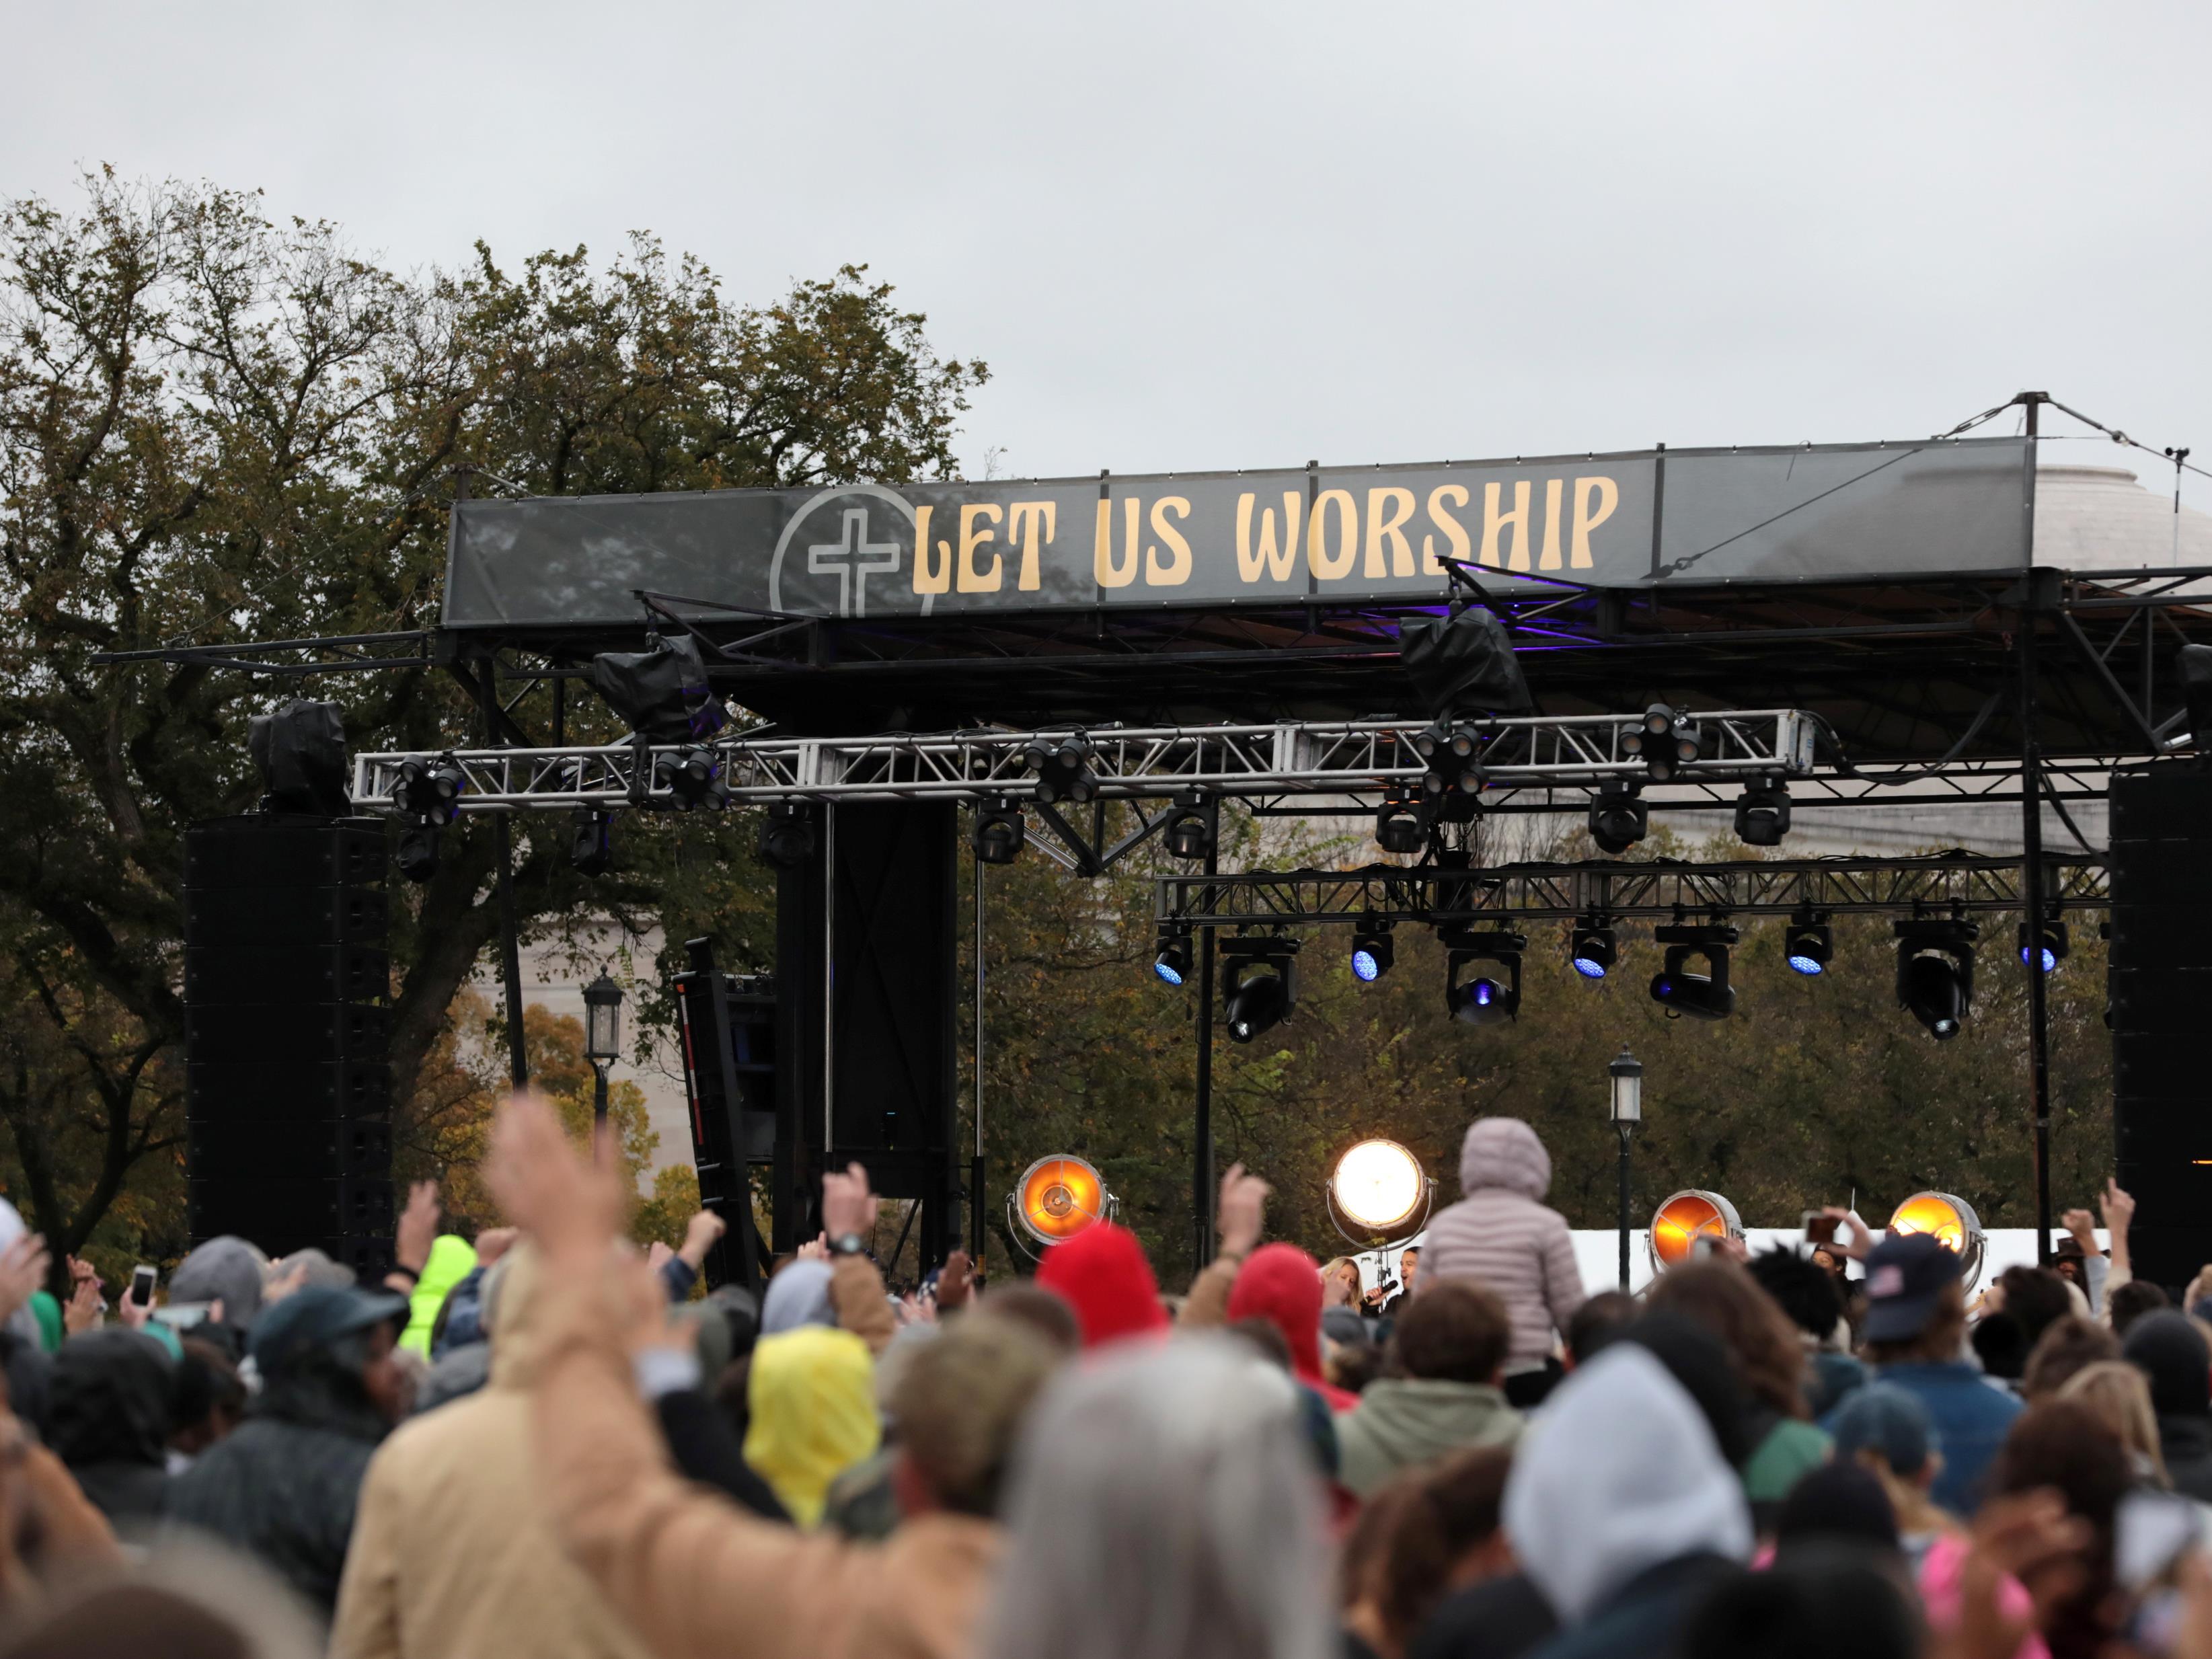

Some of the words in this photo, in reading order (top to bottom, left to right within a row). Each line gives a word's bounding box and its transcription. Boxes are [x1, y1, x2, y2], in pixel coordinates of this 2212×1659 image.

[913, 502, 1057, 594] LET
[1094, 496, 1192, 588] US
[1236, 477, 1618, 582] WORSHIP
